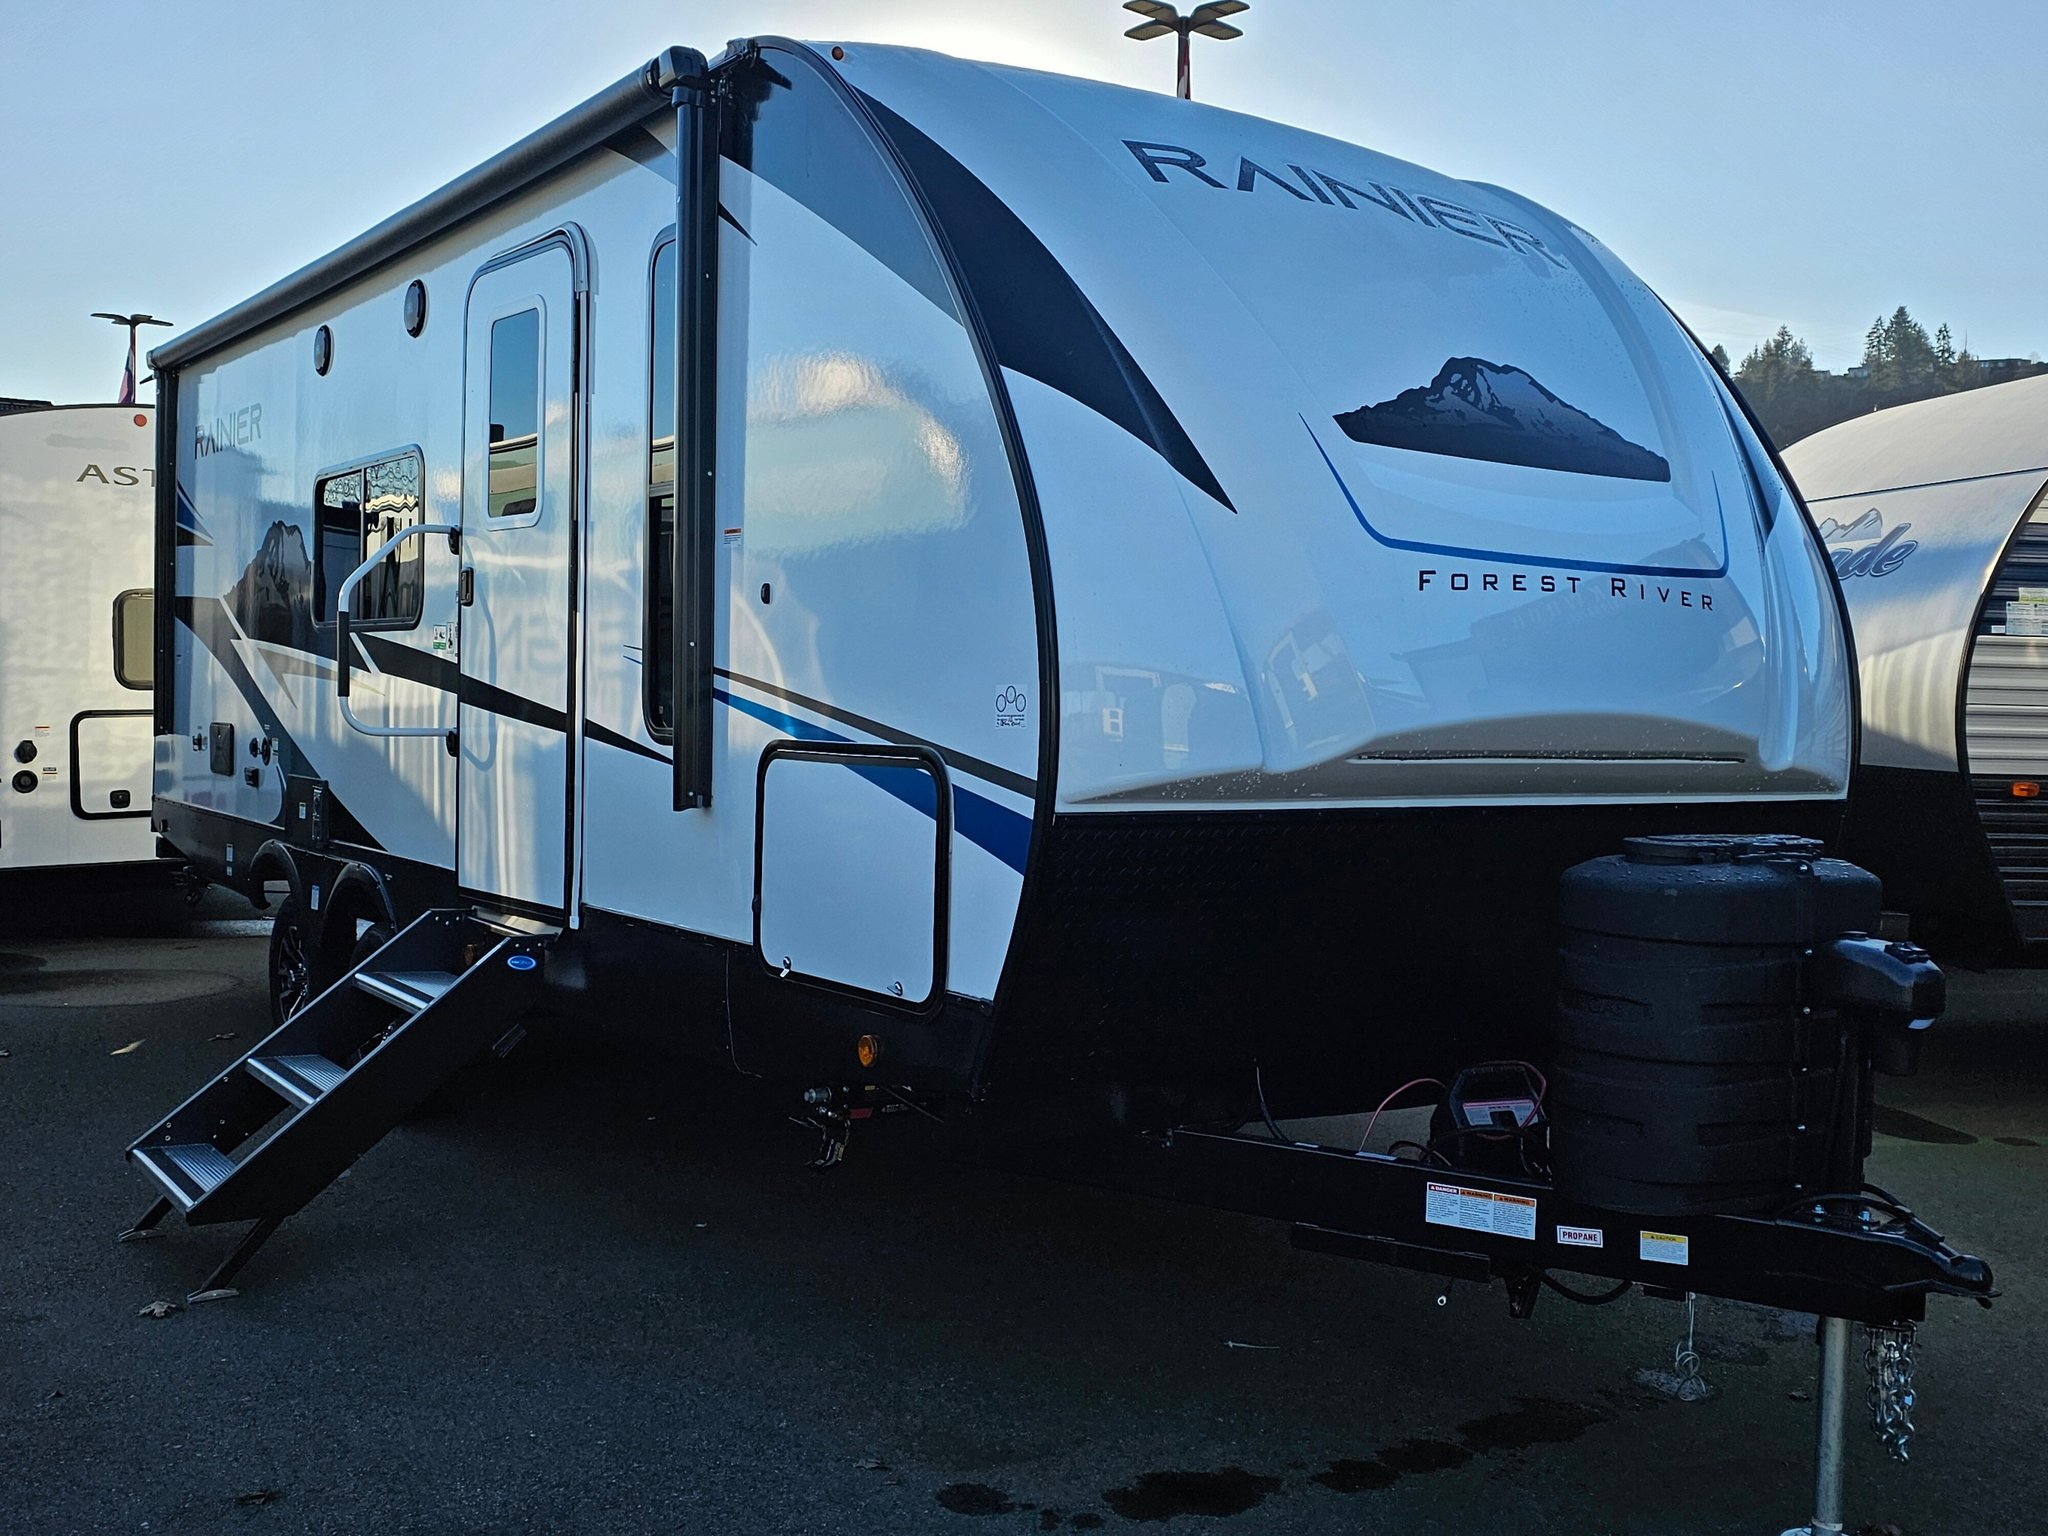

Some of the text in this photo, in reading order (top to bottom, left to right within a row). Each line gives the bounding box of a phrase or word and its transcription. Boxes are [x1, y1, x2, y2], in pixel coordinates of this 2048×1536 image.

[1122, 139, 1567, 269] RAINIER
[194, 402, 262, 460] RAINIER
[1418, 570, 1581, 594] FOREST
[1611, 577, 1713, 611] RIVER
[1562, 1231, 1598, 1242] PROPANE
